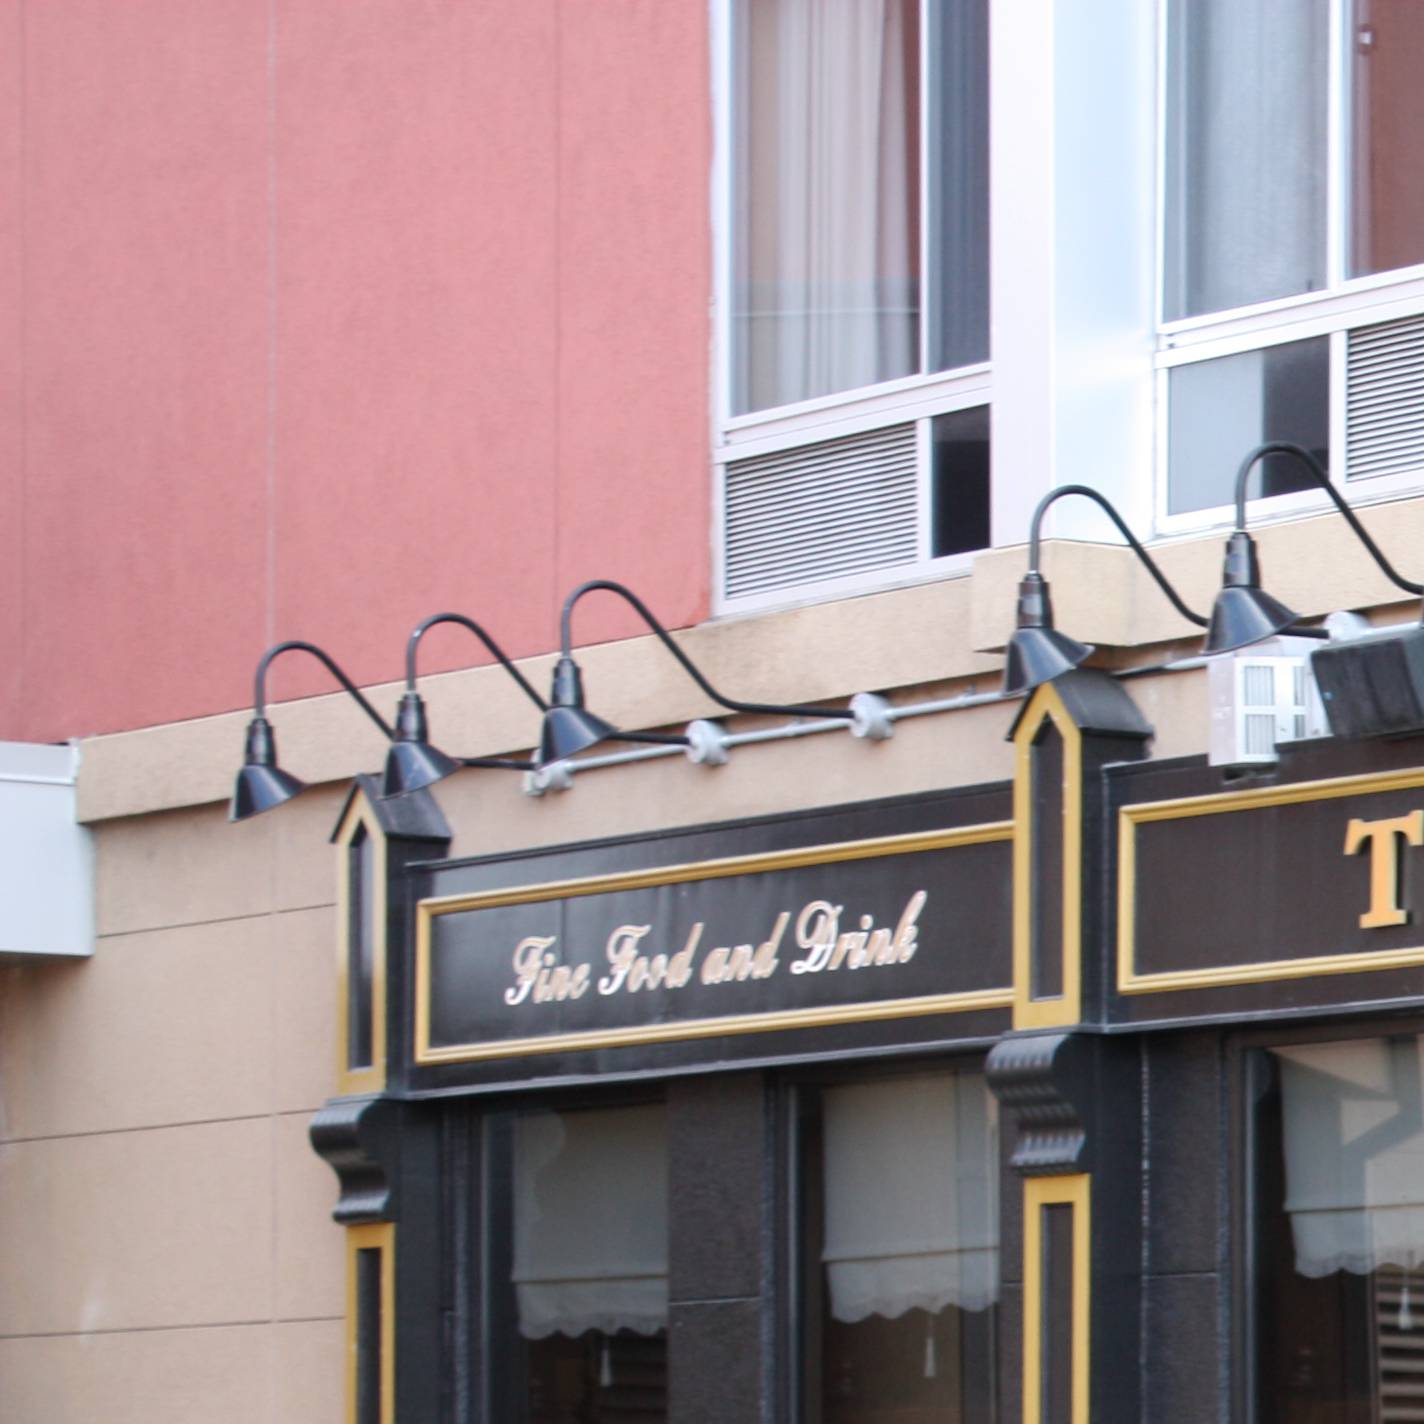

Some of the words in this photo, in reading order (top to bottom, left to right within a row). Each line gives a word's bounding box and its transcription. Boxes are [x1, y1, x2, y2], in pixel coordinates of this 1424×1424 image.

[504, 935, 592, 1006] Fine
[597, 922, 704, 996] Food
[701, 911, 791, 986] and
[790, 890, 928, 976] Drink
